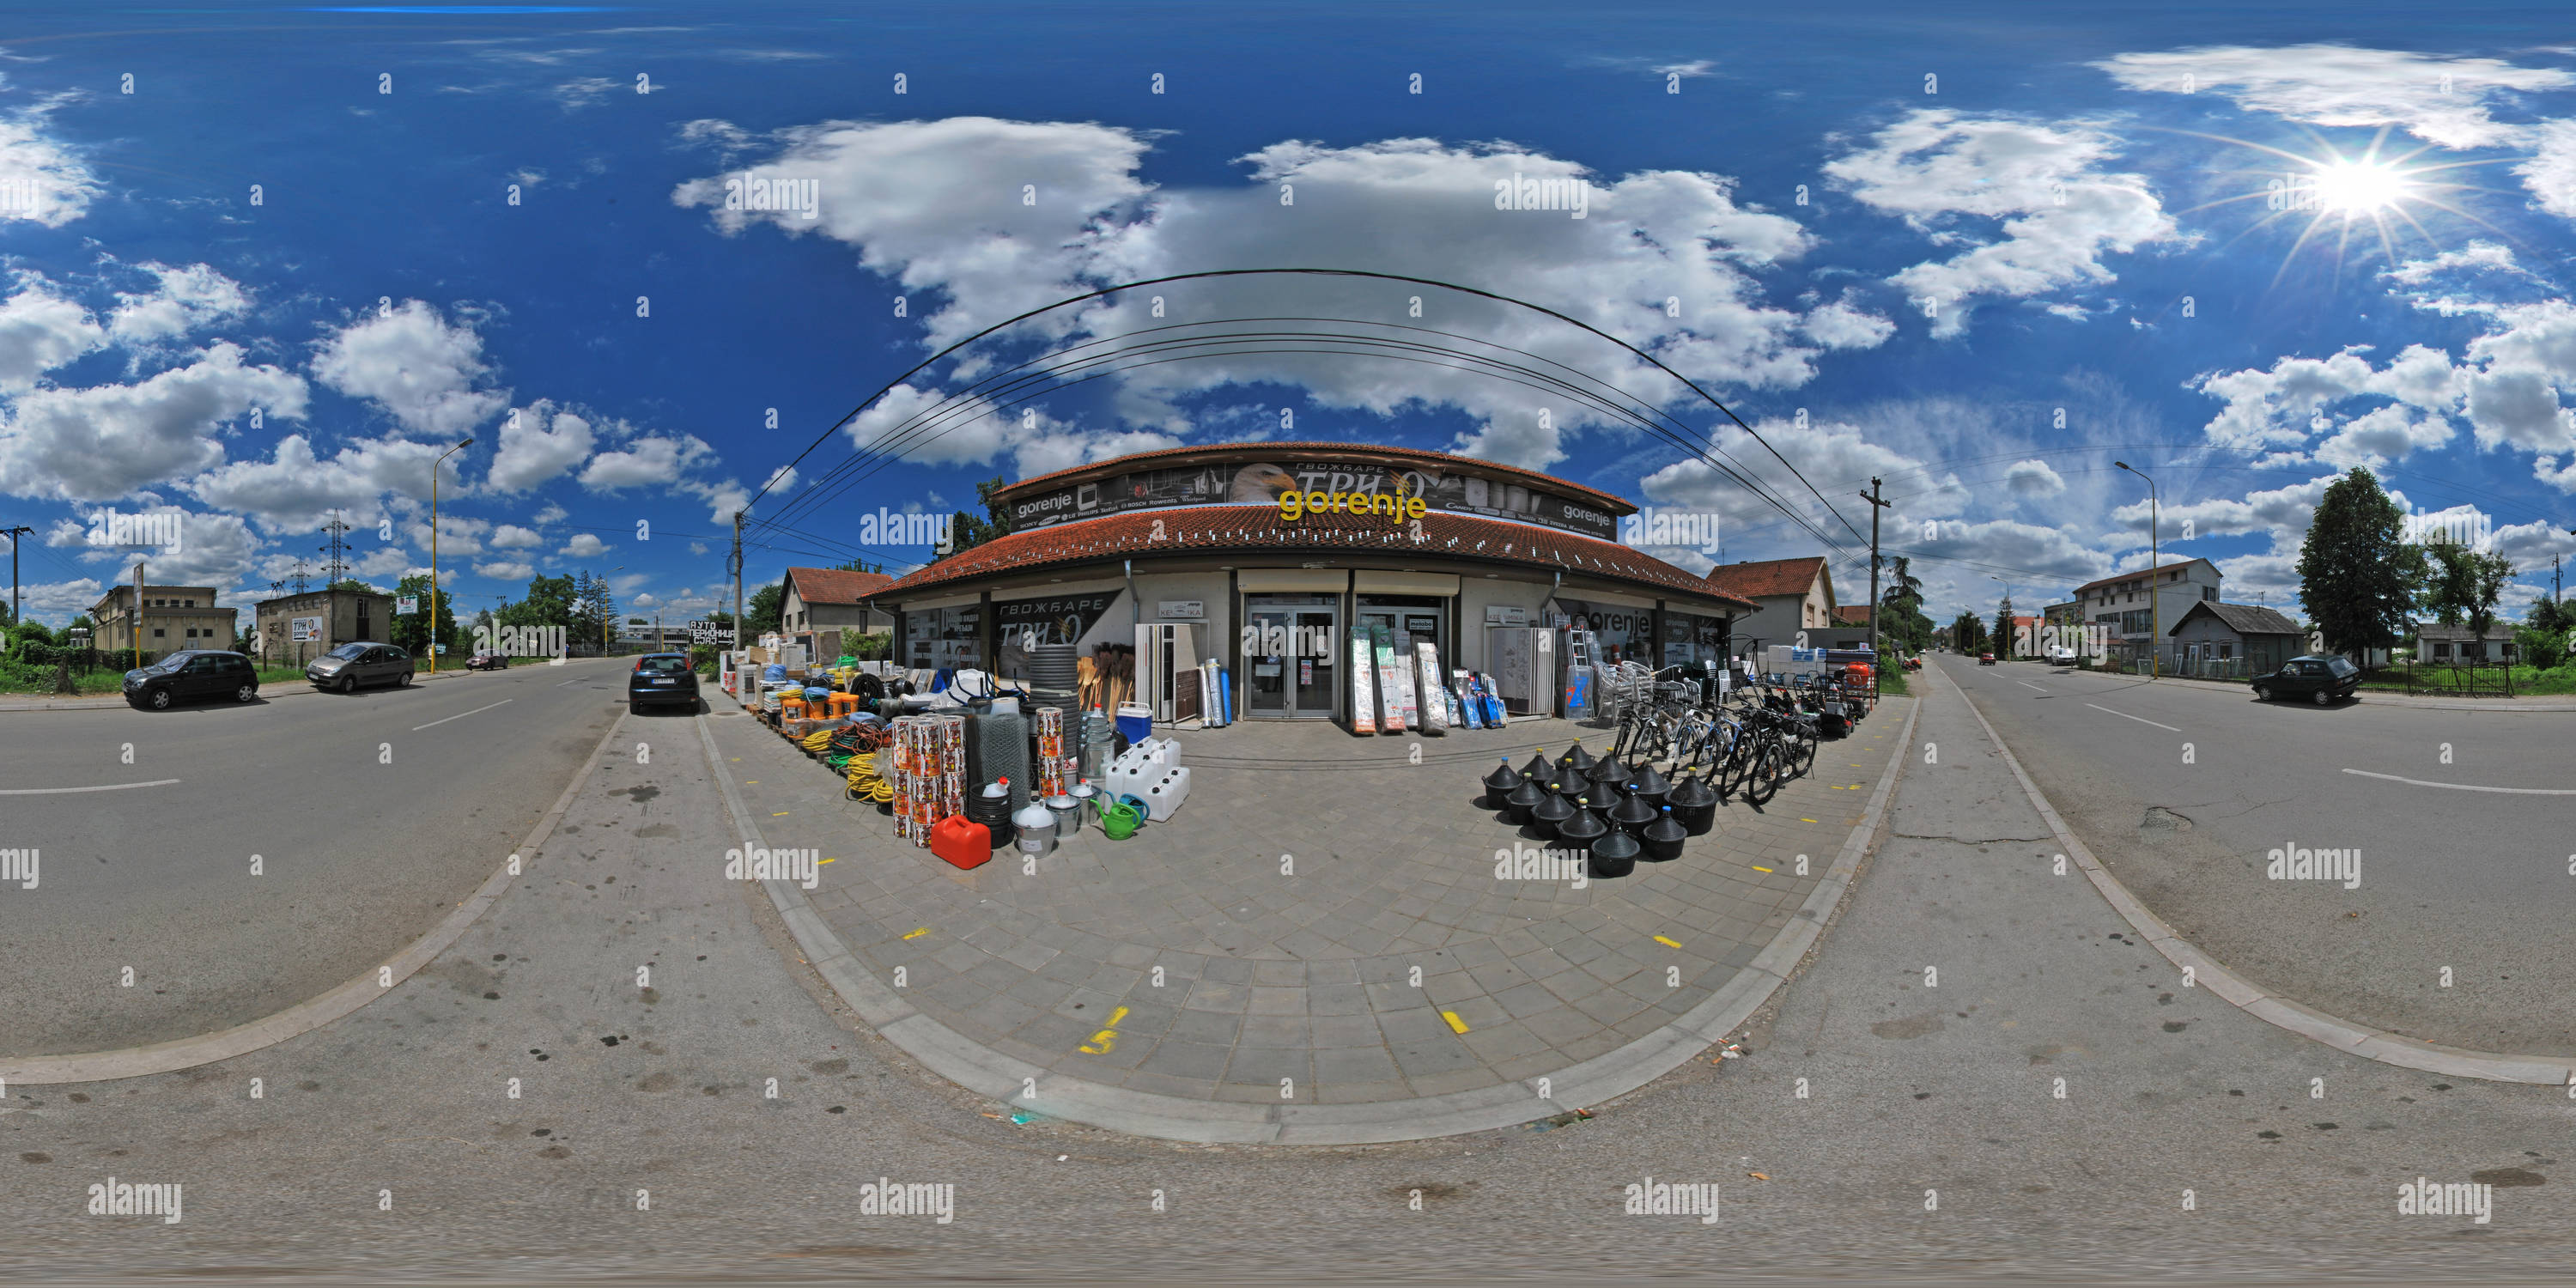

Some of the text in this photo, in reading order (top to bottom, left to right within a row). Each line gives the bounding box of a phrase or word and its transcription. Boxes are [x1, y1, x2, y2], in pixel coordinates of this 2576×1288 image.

[1018, 493, 1072, 519] gorenje
[1279, 489, 1427, 525] gorenje
[1564, 505, 1610, 527] gorenje
[690, 621, 716, 629] АУТО
